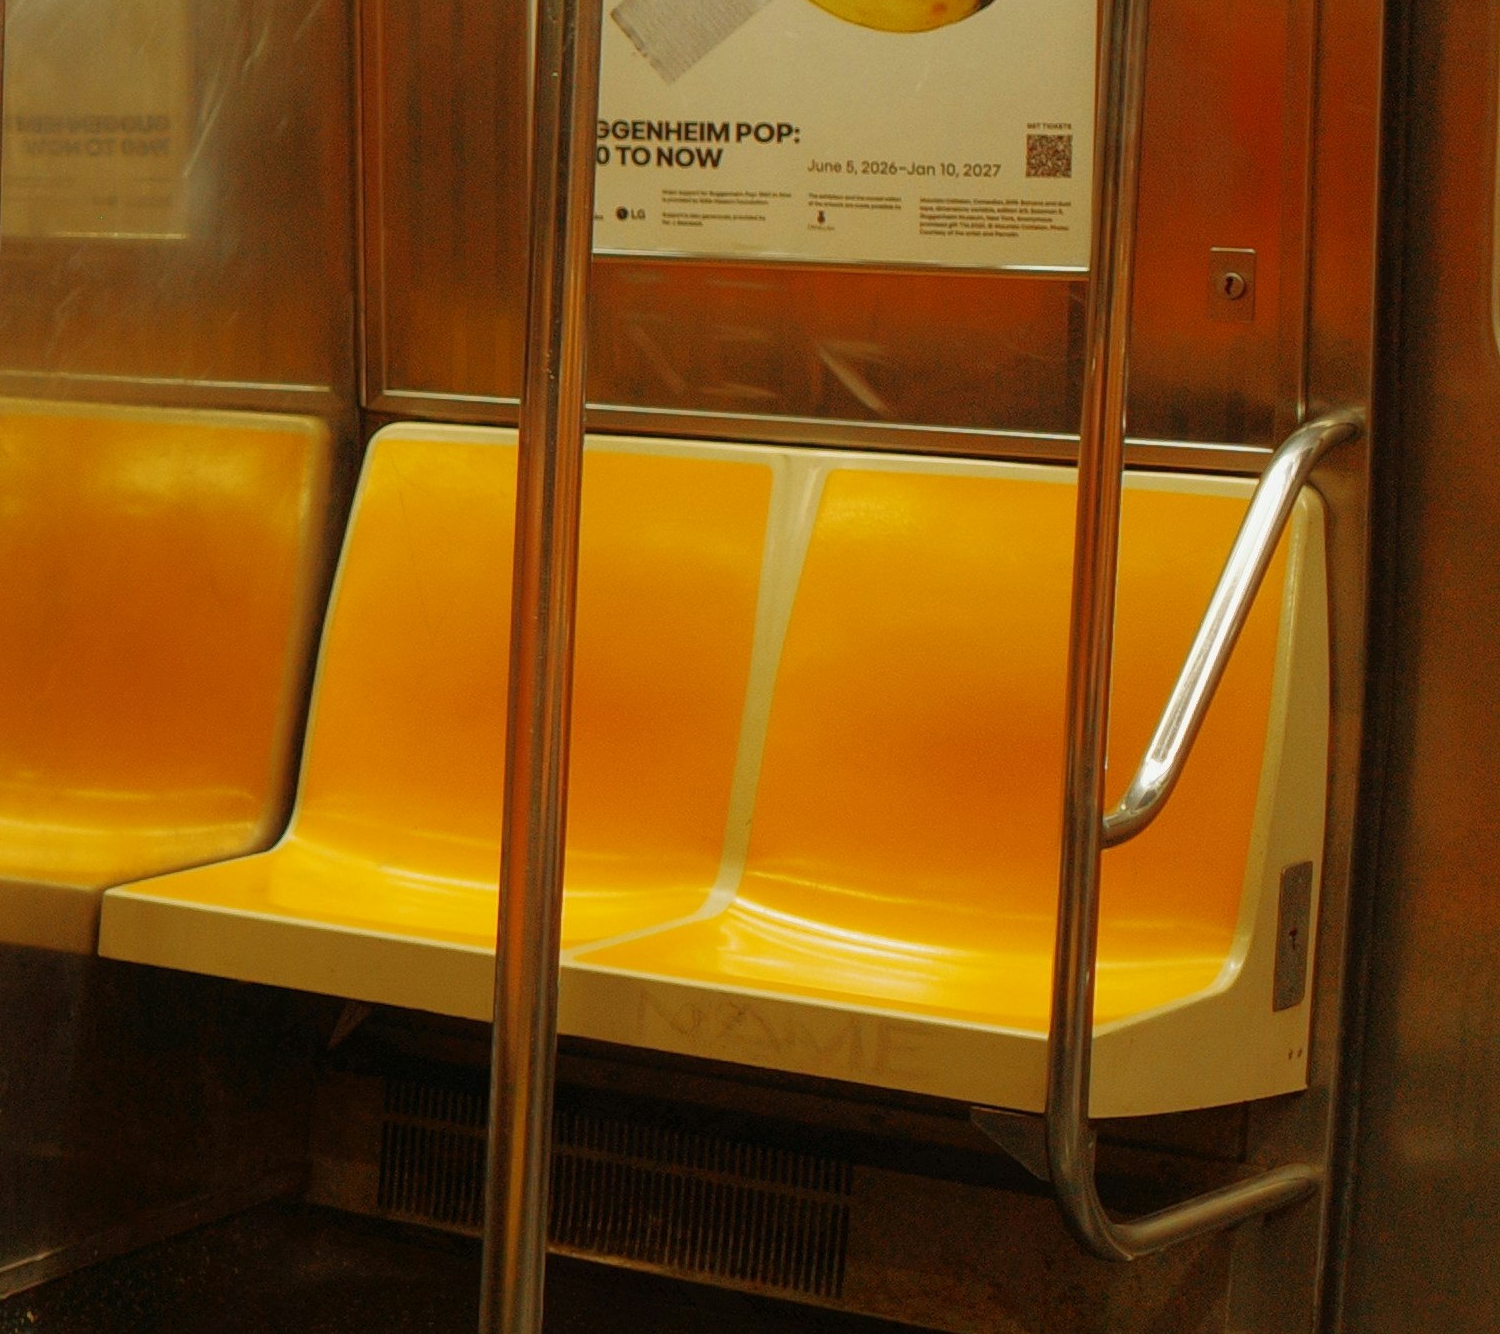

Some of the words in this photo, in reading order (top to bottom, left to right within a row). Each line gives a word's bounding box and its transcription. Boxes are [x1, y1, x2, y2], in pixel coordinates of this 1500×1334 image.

[597, 120, 731, 143] GGENHEIM
[735, 122, 801, 144] POP:
[616, 147, 651, 166] TO
[656, 147, 724, 168] NOW
[807, 159, 843, 173] June
[846, 161, 858, 175] 5,
[941, 163, 960, 178] 10,
[963, 163, 1002, 178] 2027
[631, 208, 646, 220] LG
